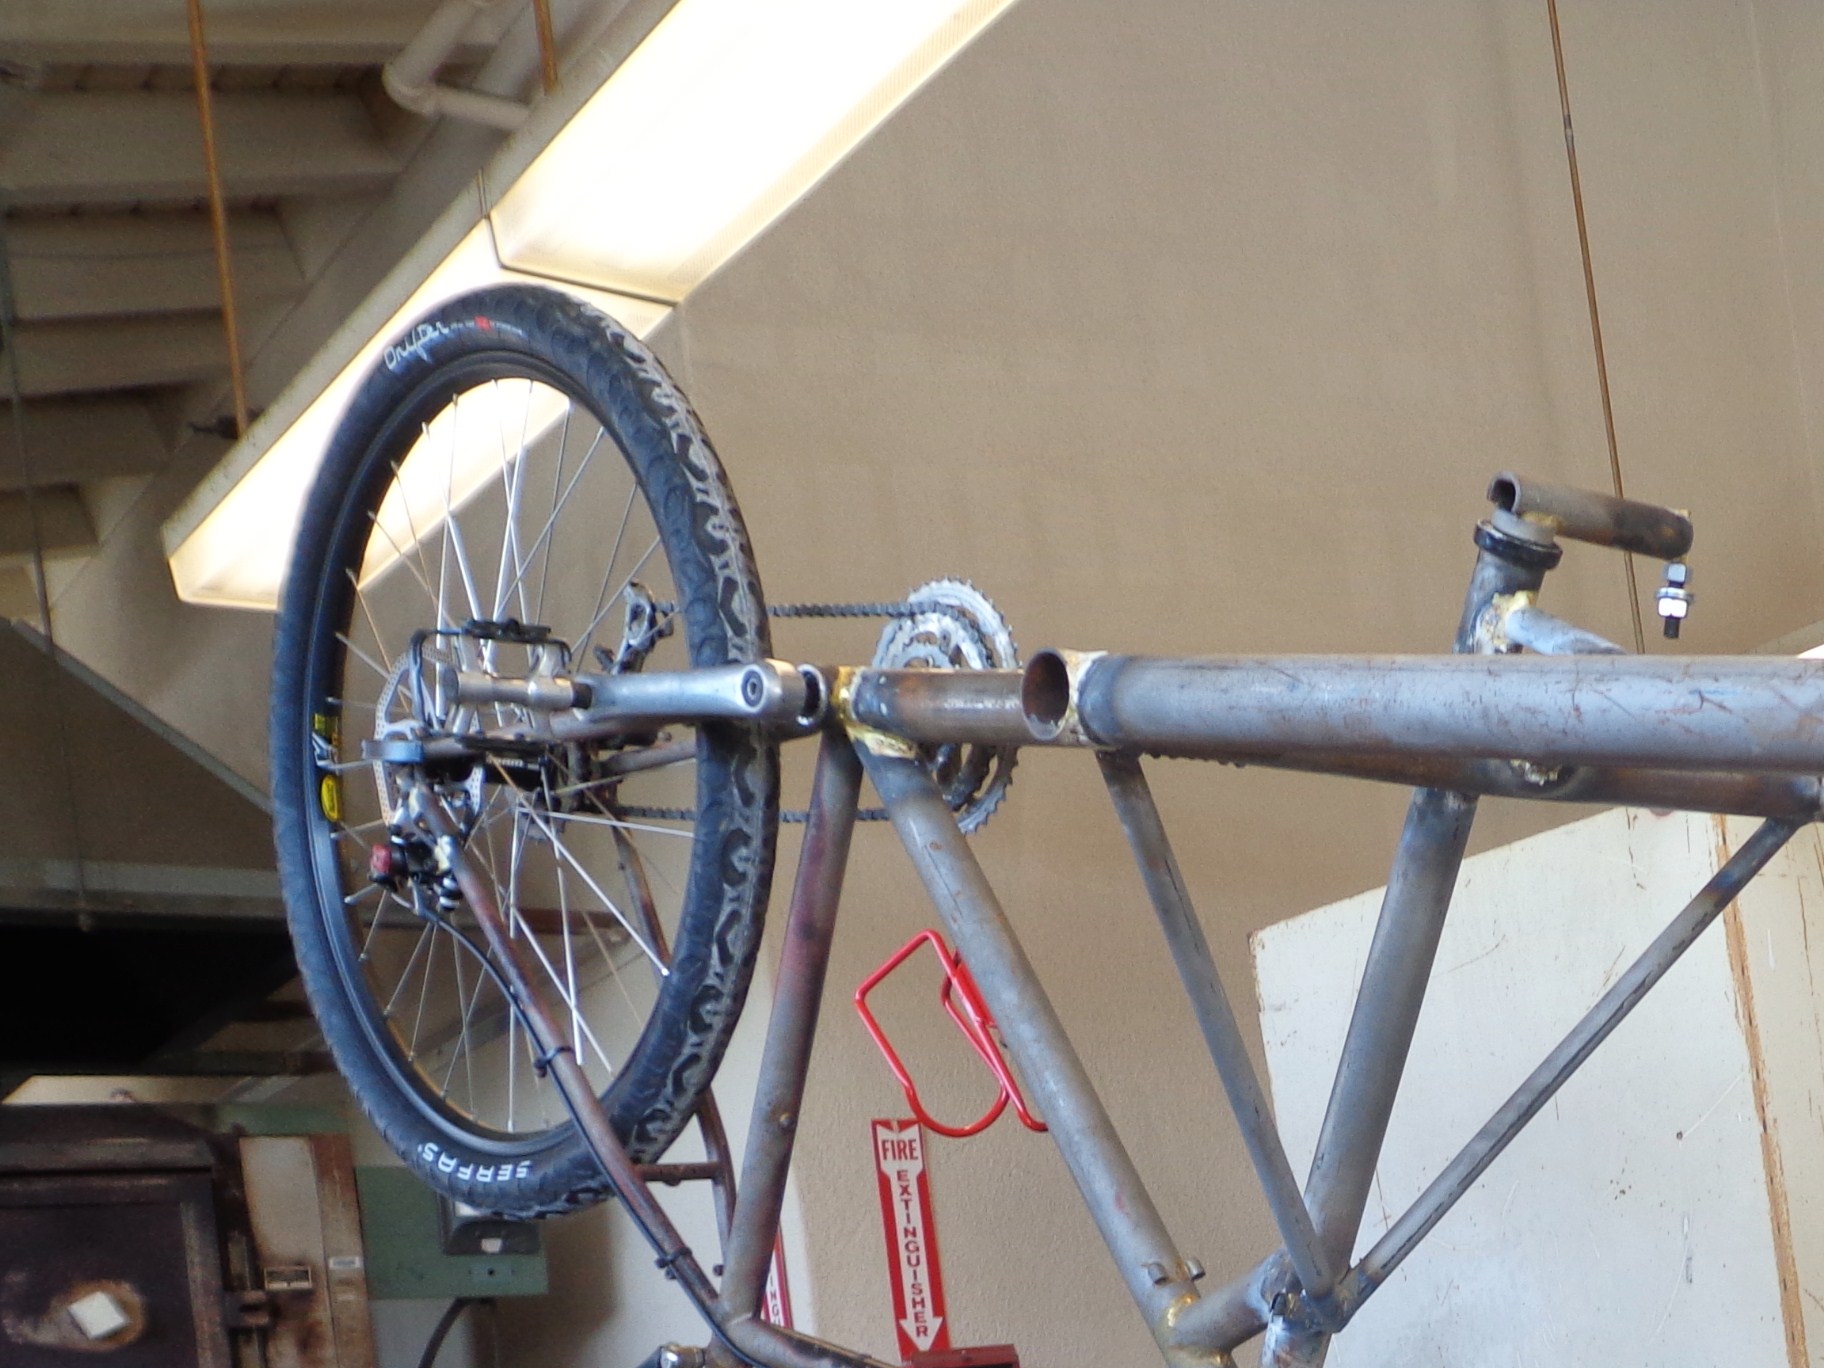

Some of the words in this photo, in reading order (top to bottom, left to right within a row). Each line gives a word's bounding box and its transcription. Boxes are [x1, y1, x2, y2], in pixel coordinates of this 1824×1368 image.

[421, 1142, 532, 1182] SERFAS
[881, 1139, 919, 1161] FIRE
[896, 1169, 928, 1338] EXTINGUISHER
